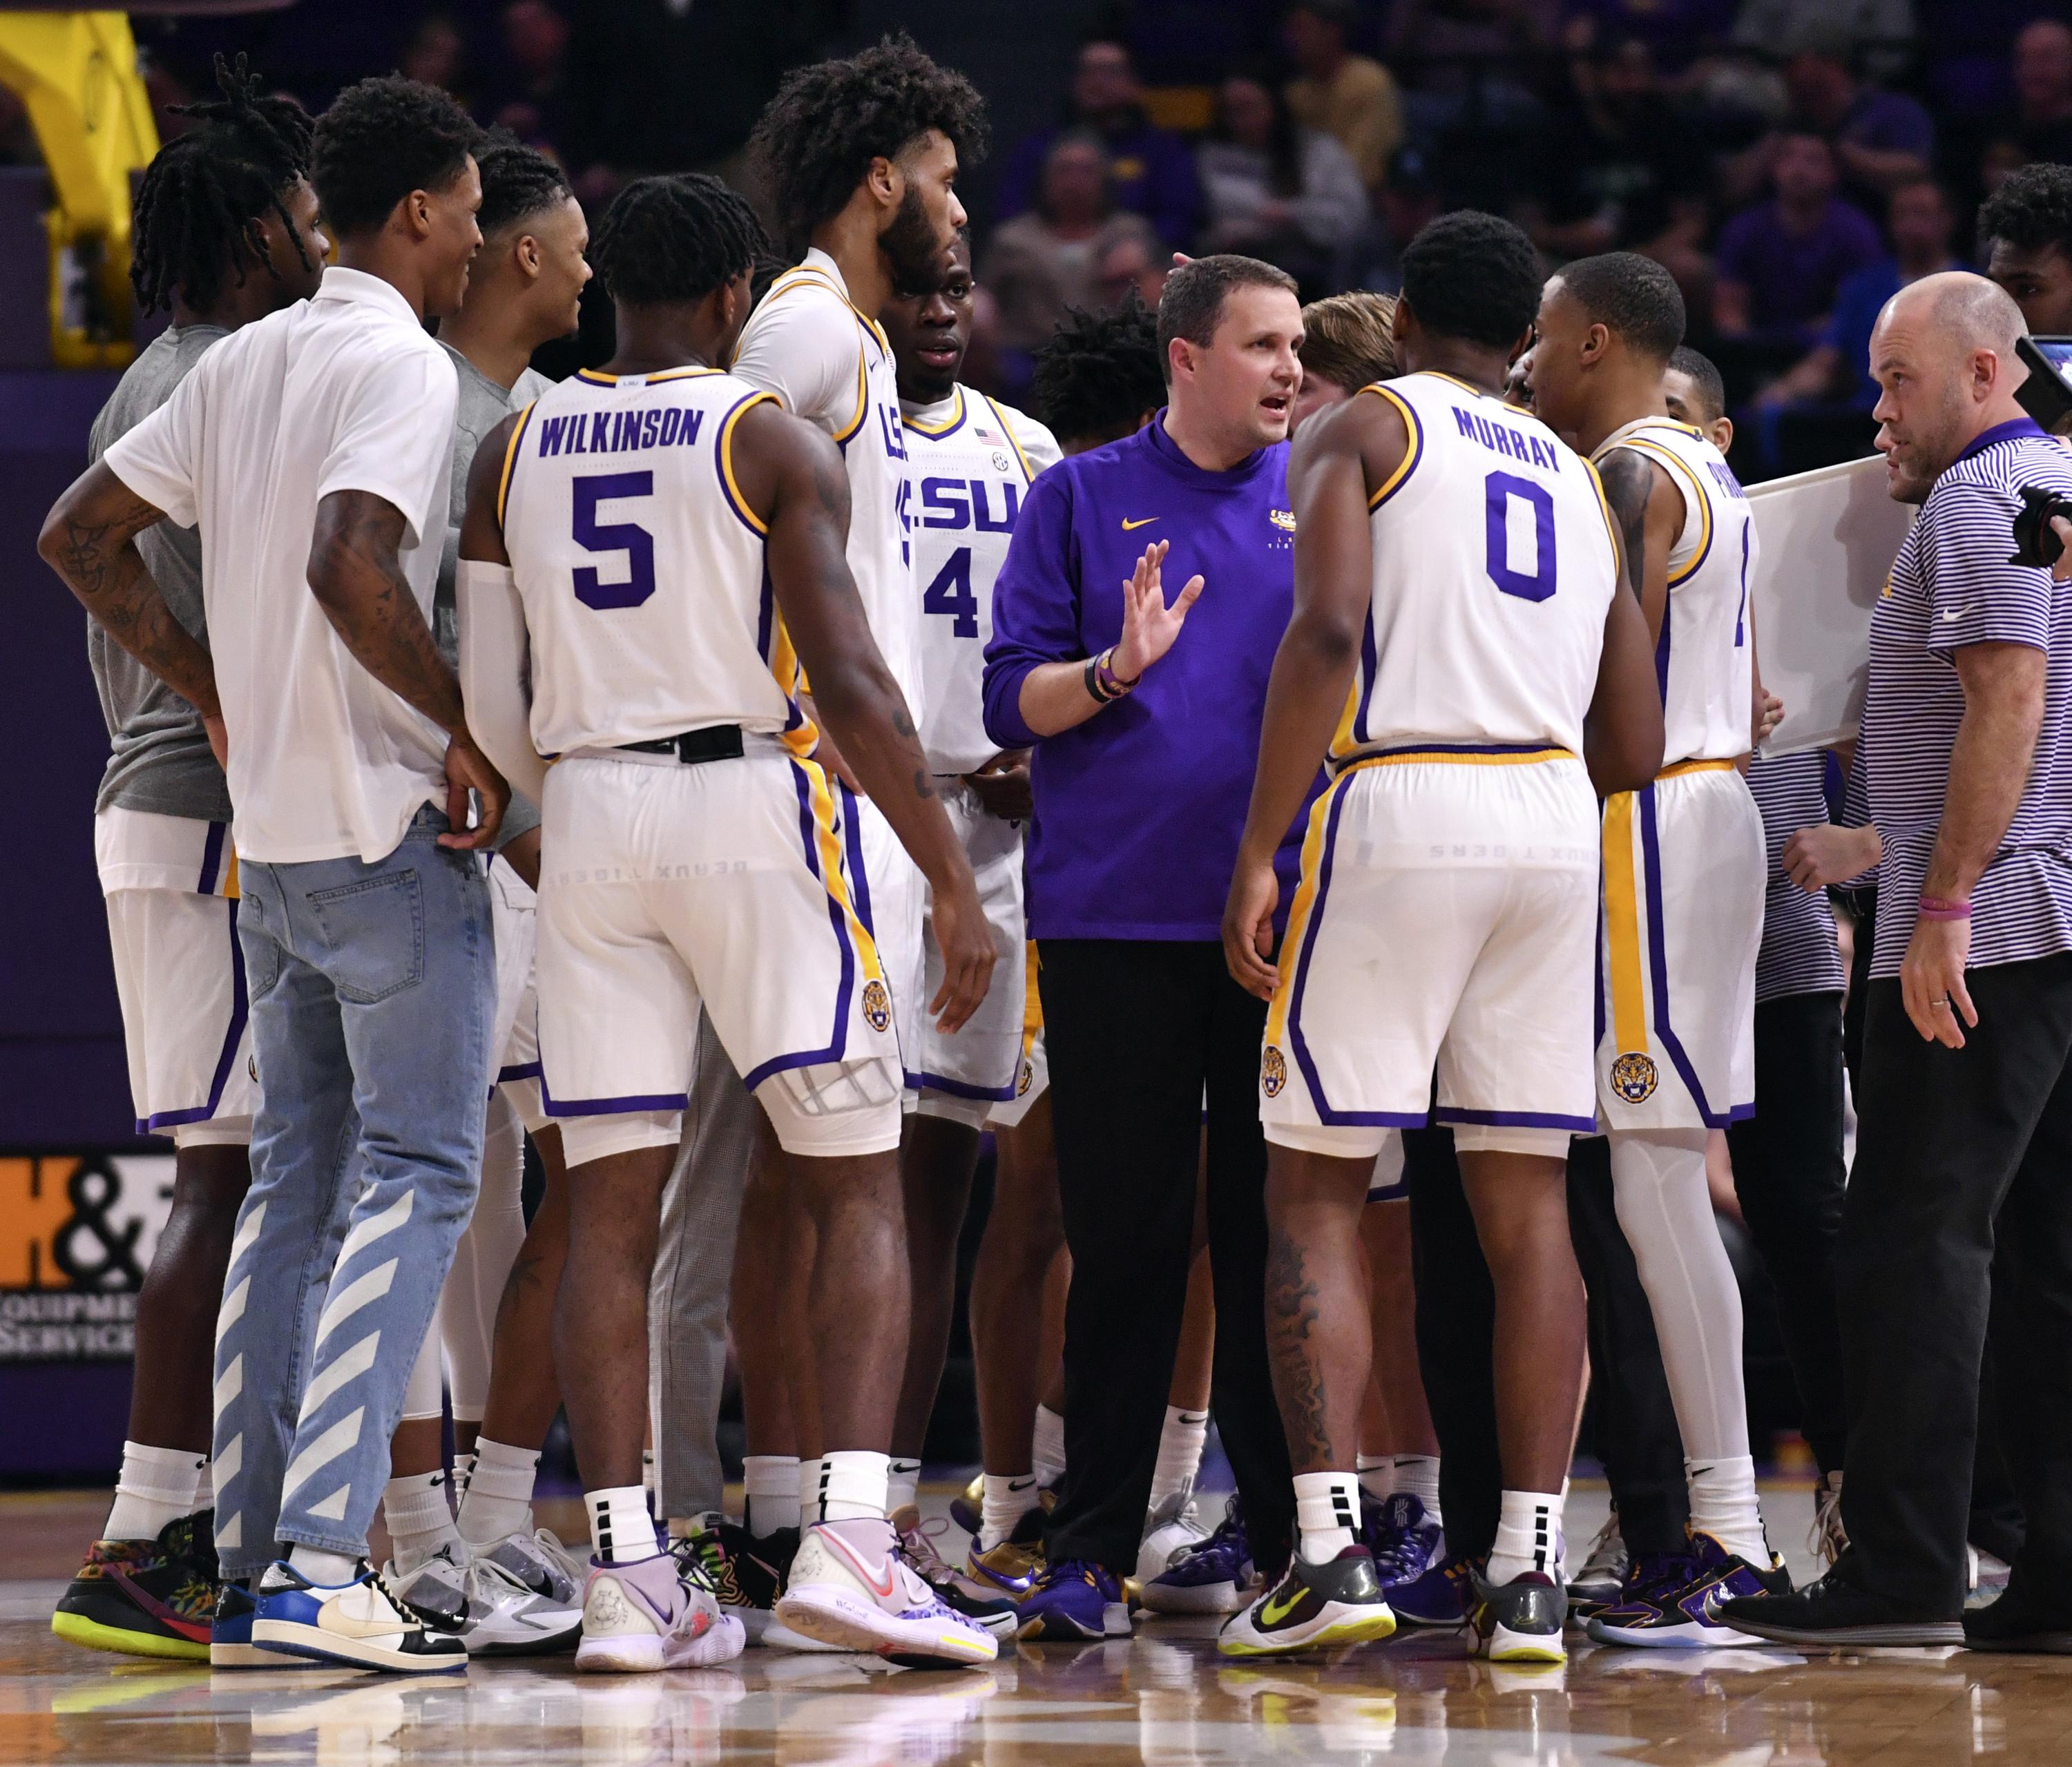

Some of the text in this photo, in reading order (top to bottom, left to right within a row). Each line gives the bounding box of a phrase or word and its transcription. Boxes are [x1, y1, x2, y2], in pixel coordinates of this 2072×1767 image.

[539, 407, 704, 458] WILKINSON
[878, 402, 909, 462] LS
[1451, 406, 1561, 473] MURRAY
[914, 476, 1021, 534] SU
[1485, 470, 1557, 604] 0
[572, 470, 656, 610] 5
[923, 547, 979, 638] 4
